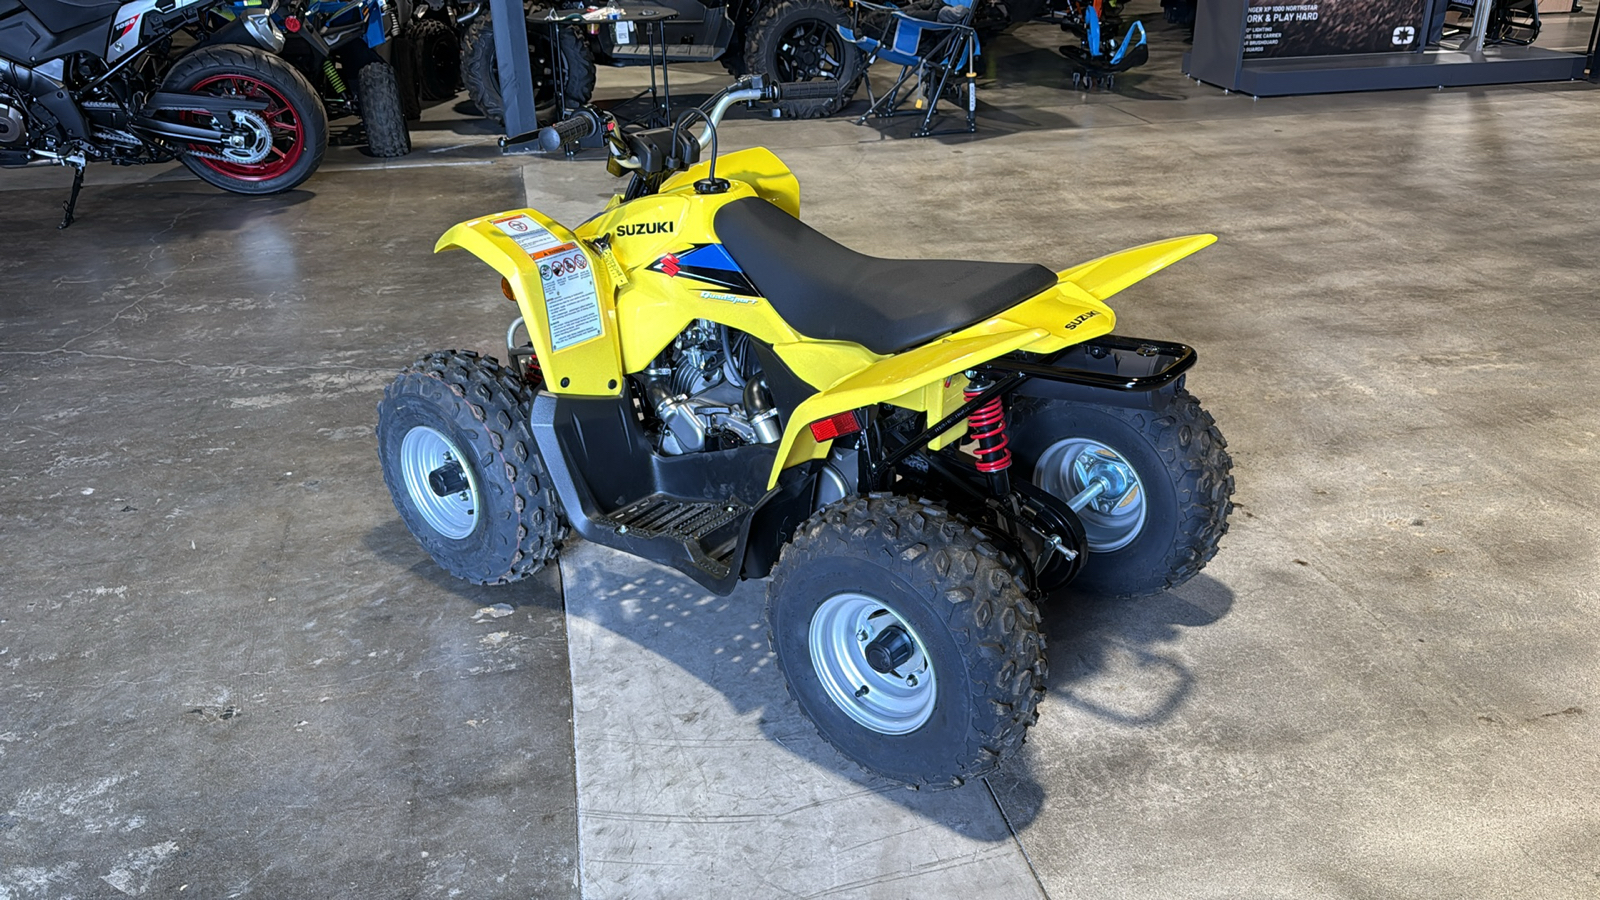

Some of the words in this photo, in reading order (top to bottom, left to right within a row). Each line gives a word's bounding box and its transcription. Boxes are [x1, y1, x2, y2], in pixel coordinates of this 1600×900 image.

[1265, 14, 1271, 22] &
[1273, 13, 1294, 22] PLAY
[1296, 12, 1318, 21] HARD
[116, 18, 136, 30] 1050
[616, 221, 674, 237] SUZUKI
[701, 291, 758, 304] QuadSport
